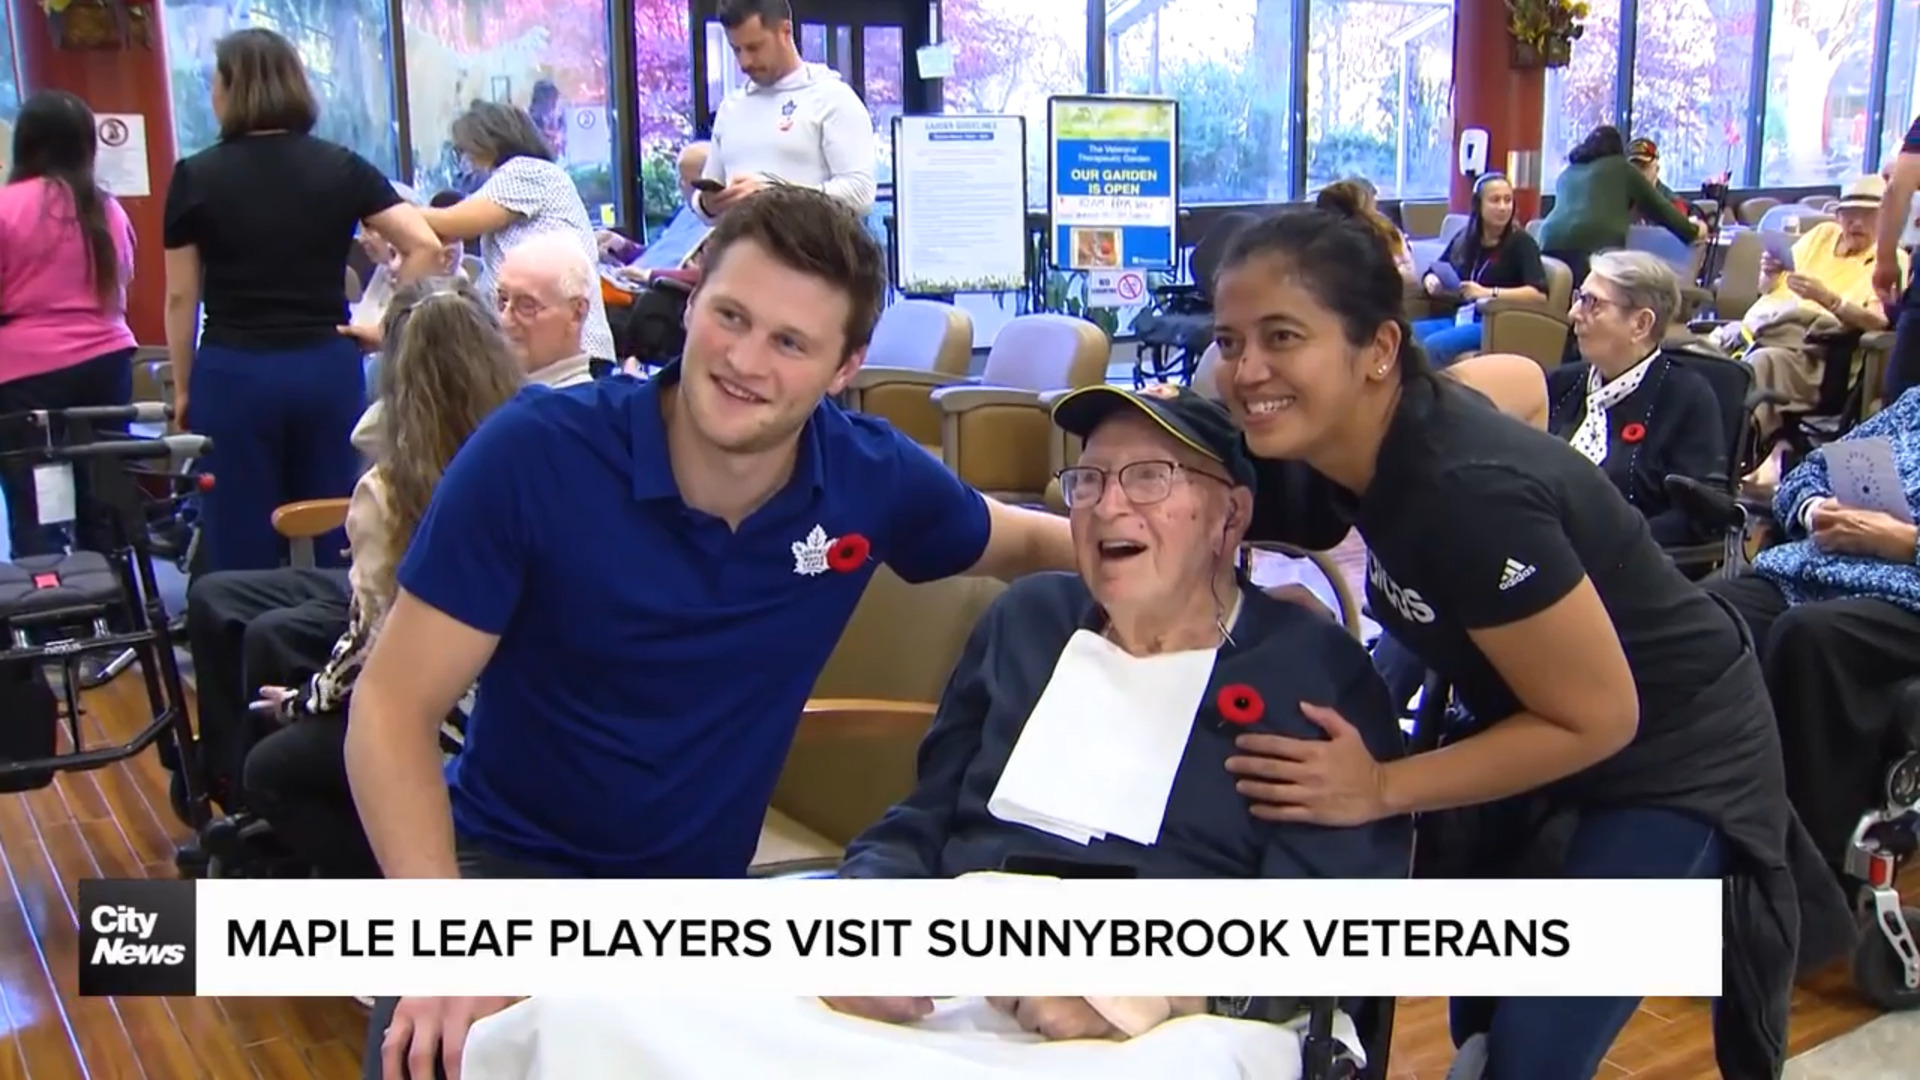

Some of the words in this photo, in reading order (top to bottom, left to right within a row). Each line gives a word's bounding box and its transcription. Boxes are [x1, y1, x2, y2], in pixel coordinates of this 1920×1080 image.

[1089, 144, 1103, 153] The
[1078, 153, 1121, 163] Therapeutic
[1123, 154, 1151, 163] Garden
[1071, 168, 1099, 181] OUR
[1102, 168, 1158, 182] GARDEN
[1089, 183, 1106, 195] IS
[1104, 183, 1140, 195] OPEN
[1499, 564, 1537, 591] adidas
